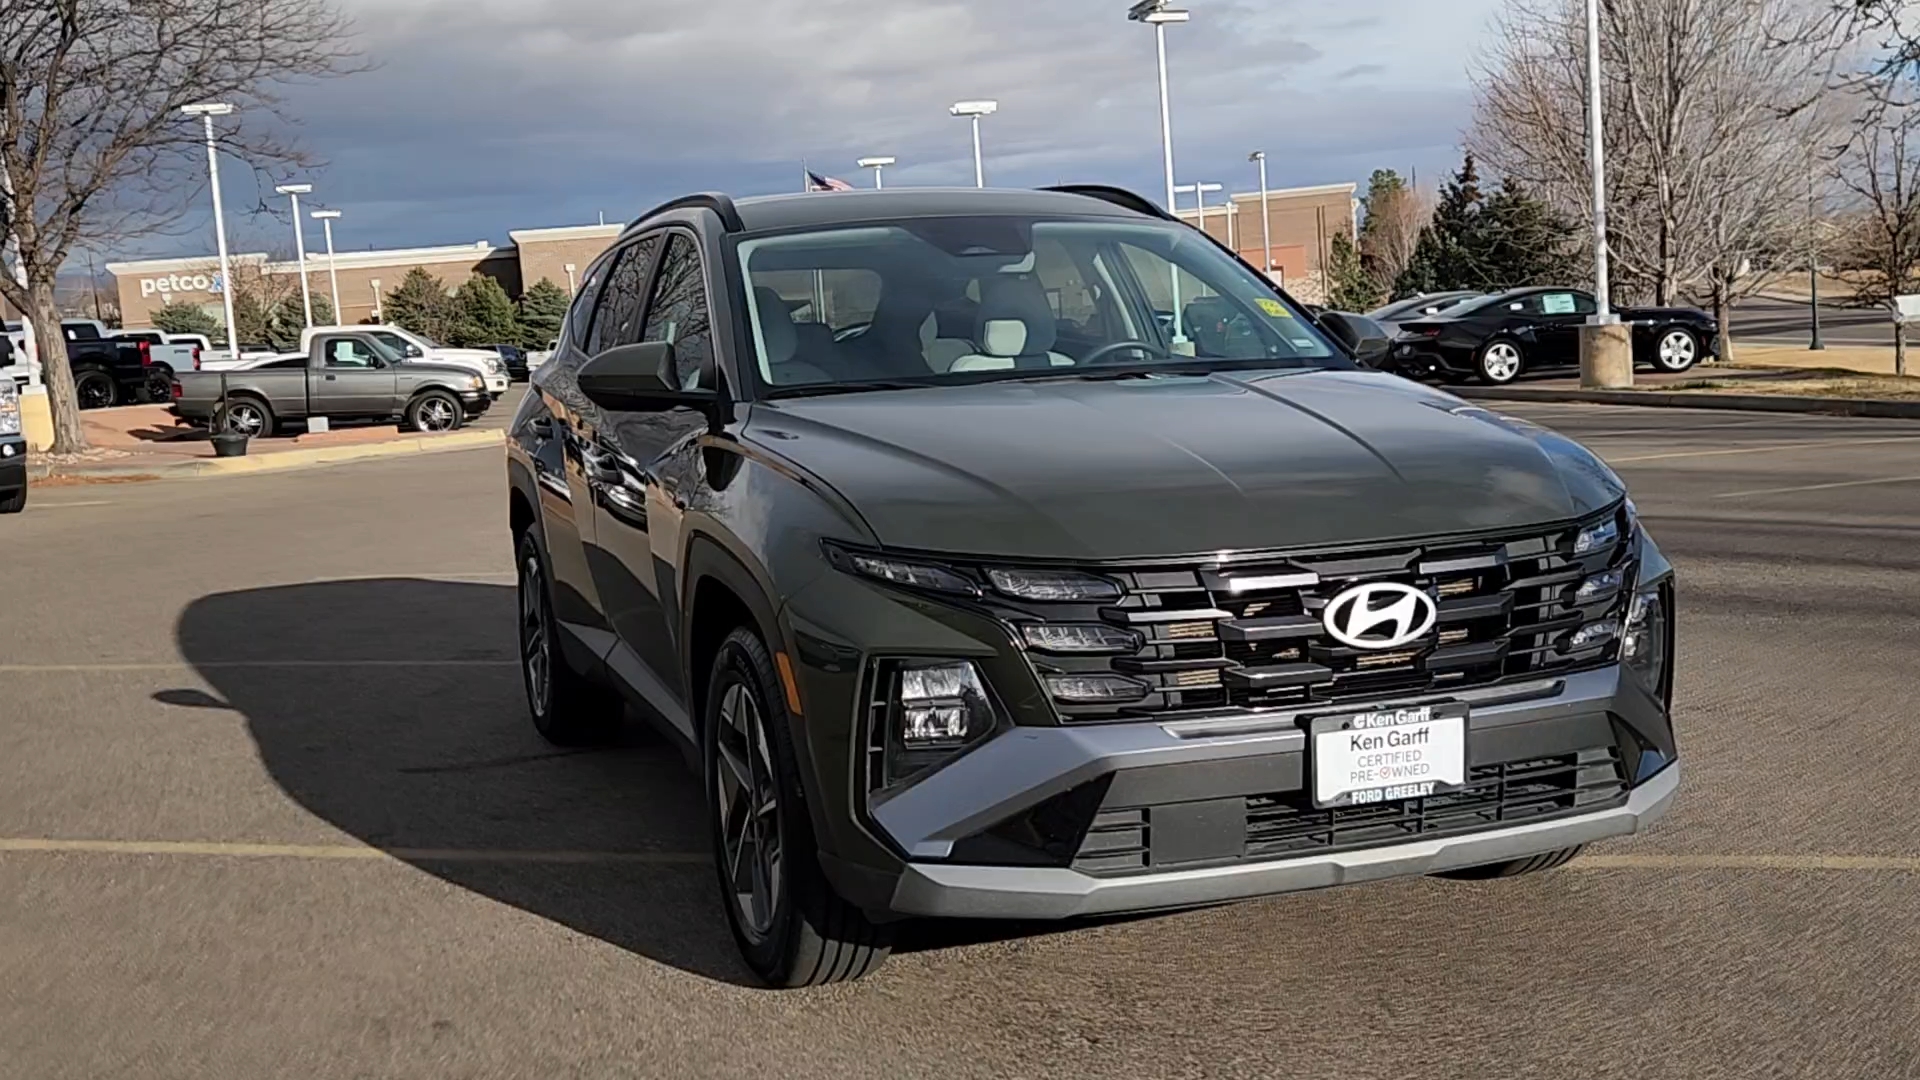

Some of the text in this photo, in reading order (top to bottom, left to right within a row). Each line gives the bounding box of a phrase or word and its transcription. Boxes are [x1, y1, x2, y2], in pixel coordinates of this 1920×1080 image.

[140, 273, 209, 298] petco
[1366, 706, 1431, 728] Ken Garff
[1350, 727, 1430, 752] Ken Garff
[1357, 749, 1422, 768] CERTIFIED
[1351, 781, 1435, 805] FORD GREELEY
